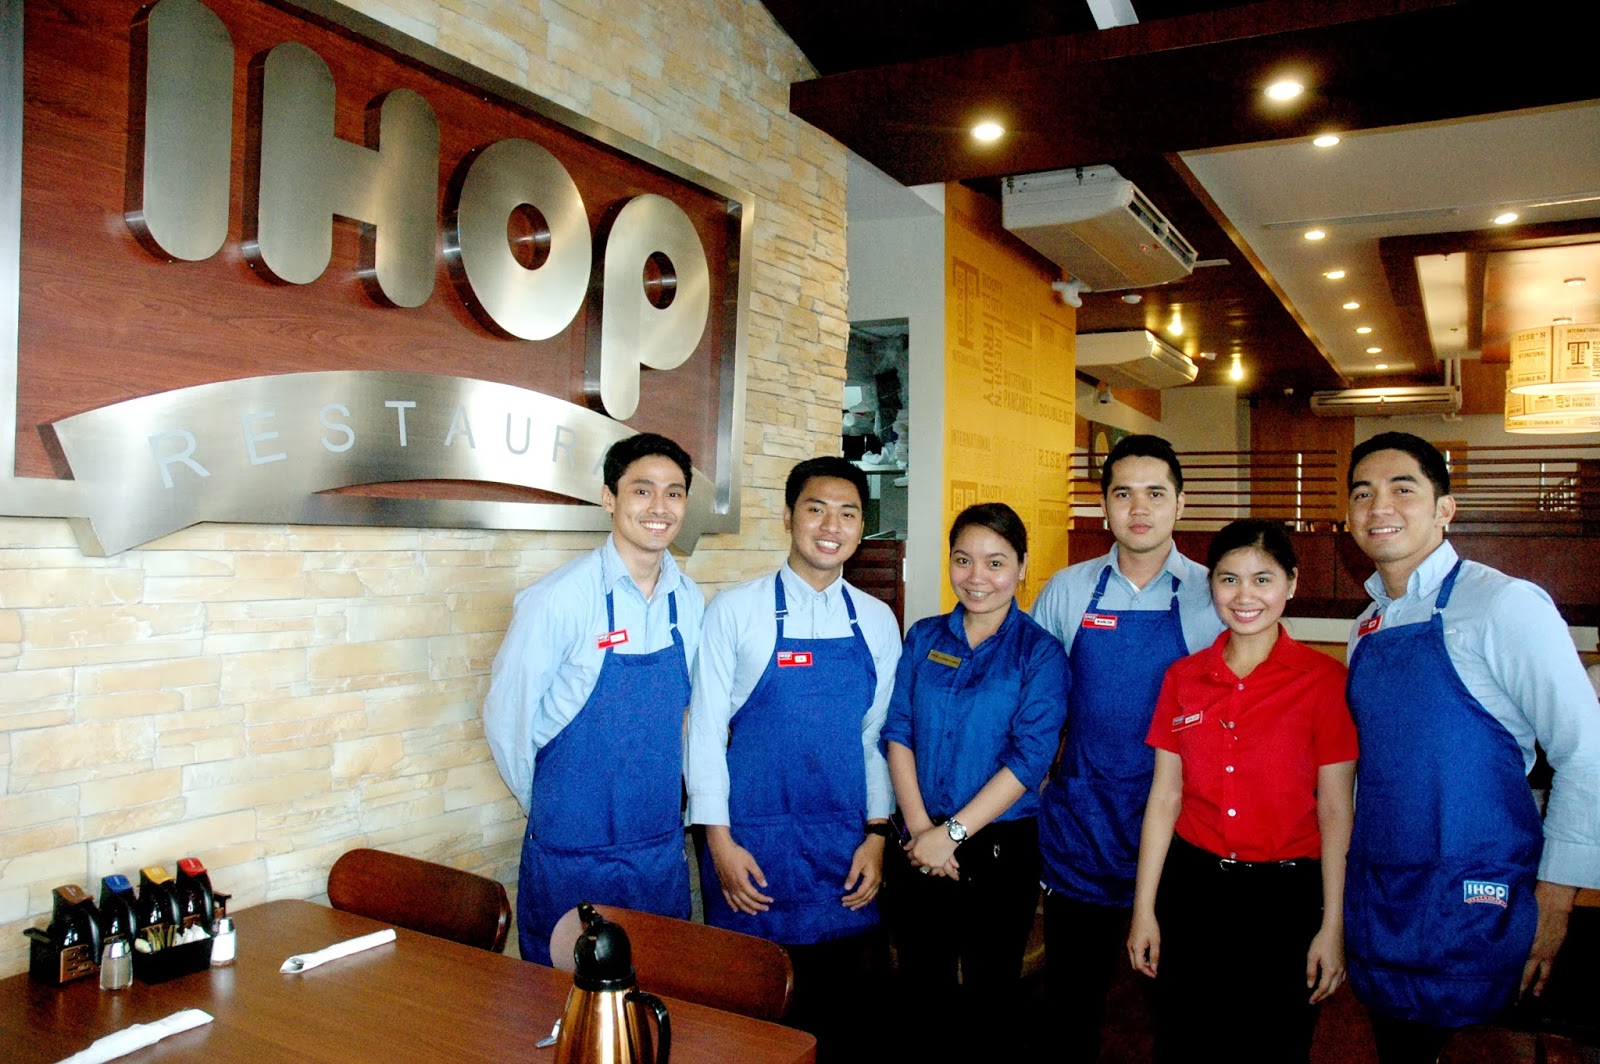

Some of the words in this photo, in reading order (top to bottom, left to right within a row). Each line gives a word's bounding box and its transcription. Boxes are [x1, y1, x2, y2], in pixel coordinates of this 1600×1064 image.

[126, 0, 711, 421] IHOP
[983, 321, 994, 406] FRUITY
[1003, 389, 1033, 416] PANCAKES
[1039, 403, 1062, 423] DOUBLE
[147, 400, 611, 489] RESTAUR
[1467, 884, 1506, 900] IHOP
